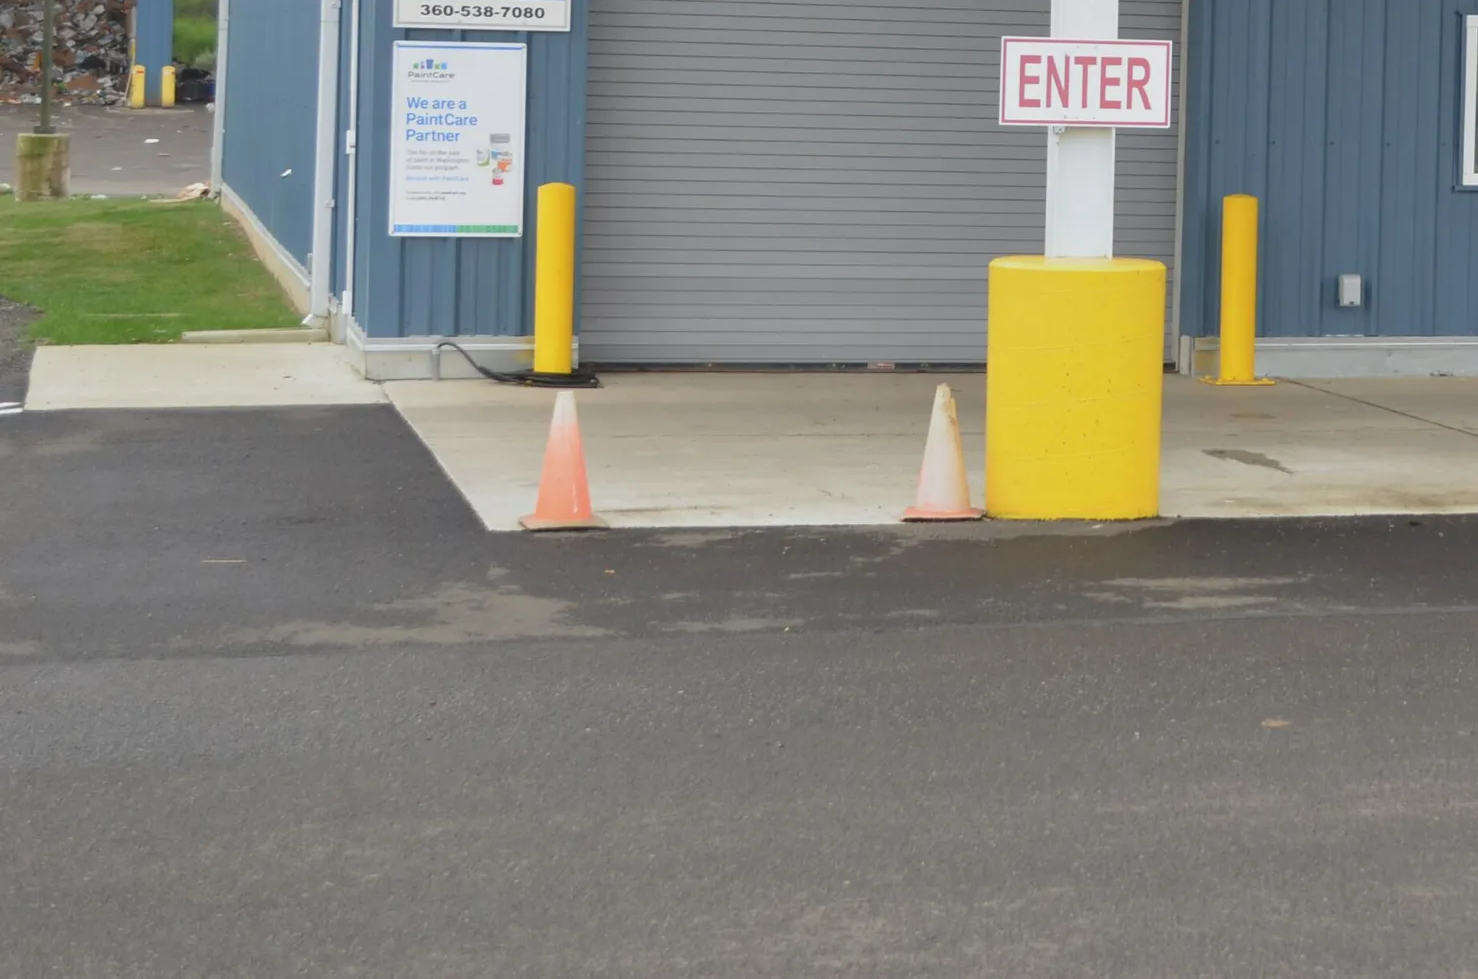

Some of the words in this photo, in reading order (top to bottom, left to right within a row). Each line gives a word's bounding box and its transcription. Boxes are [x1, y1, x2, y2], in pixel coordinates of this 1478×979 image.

[420, 5, 545, 19] 360-538-7080
[408, 71, 455, 79] PaintCare
[1019, 55, 1152, 110] ENTER
[406, 97, 428, 109] We
[432, 99, 455, 109] are
[459, 100, 467, 110] a
[406, 113, 477, 126] PaintCare
[406, 129, 461, 142] Partner
